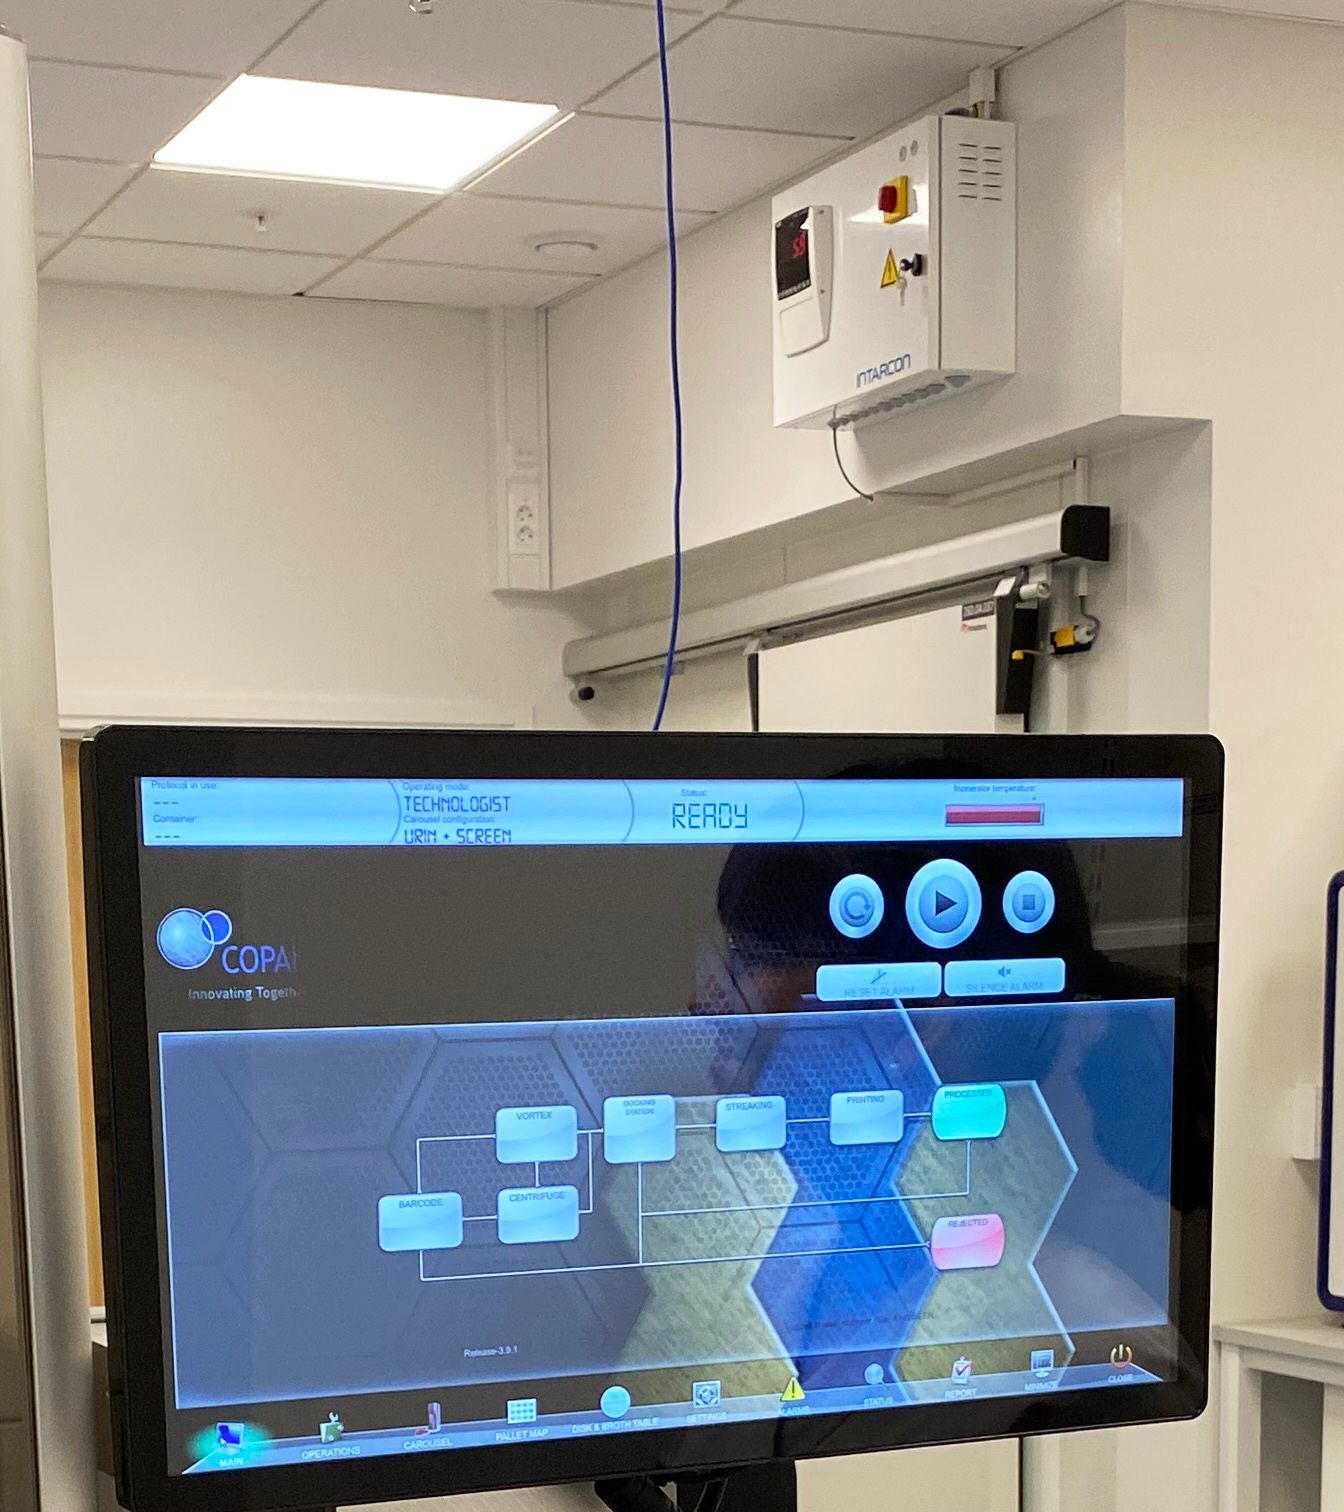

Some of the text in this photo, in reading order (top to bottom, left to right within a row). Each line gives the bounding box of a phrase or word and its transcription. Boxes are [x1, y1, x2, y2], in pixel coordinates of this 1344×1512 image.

[856, 353, 911, 388] INTARCON
[151, 780, 219, 790] Protocol in use:
[403, 782, 470, 793] Operating mode:
[992, 784, 1036, 795] temperature:
[404, 796, 511, 812] TECHNOLOGIST
[152, 814, 198, 824] Container:
[403, 815, 496, 825] Carousel configuration:
[672, 802, 748, 829] READY
[404, 829, 437, 844] URIN
[456, 828, 512, 844] SCREEN
[844, 986, 915, 997] RESET ALARM
[966, 982, 1044, 994] SILENCE ALARM
[188, 987, 253, 1002] Innovating
[846, 1094, 885, 1104] PRINTING
[944, 1089, 993, 1099] PROCESSED
[725, 1100, 774, 1111] STREAKING
[516, 1111, 553, 1121] VORTEX
[508, 1191, 566, 1202] CENTRIFUGE
[398, 1198, 443, 1209] BARCODE
[948, 1218, 989, 1228] REJECTED
[1108, 1373, 1134, 1384] CLOSE
[1024, 1381, 1059, 1391] MINIMIZE
[944, 1388, 977, 1399] REPORT
[864, 1396, 894, 1407] STATUS
[778, 1406, 811, 1416] ALARMS
[686, 1412, 728, 1424] SETTINGS
[572, 1423, 593, 1434] DISK
[601, 1420, 631, 1431] BROTH
[632, 1417, 660, 1429] TABLE
[495, 1428, 549, 1442] PALLET MAP
[403, 1438, 453, 1450] CAROUSEL
[301, 1445, 361, 1461] OPERATIONS
[219, 1458, 245, 1468] MAIN
